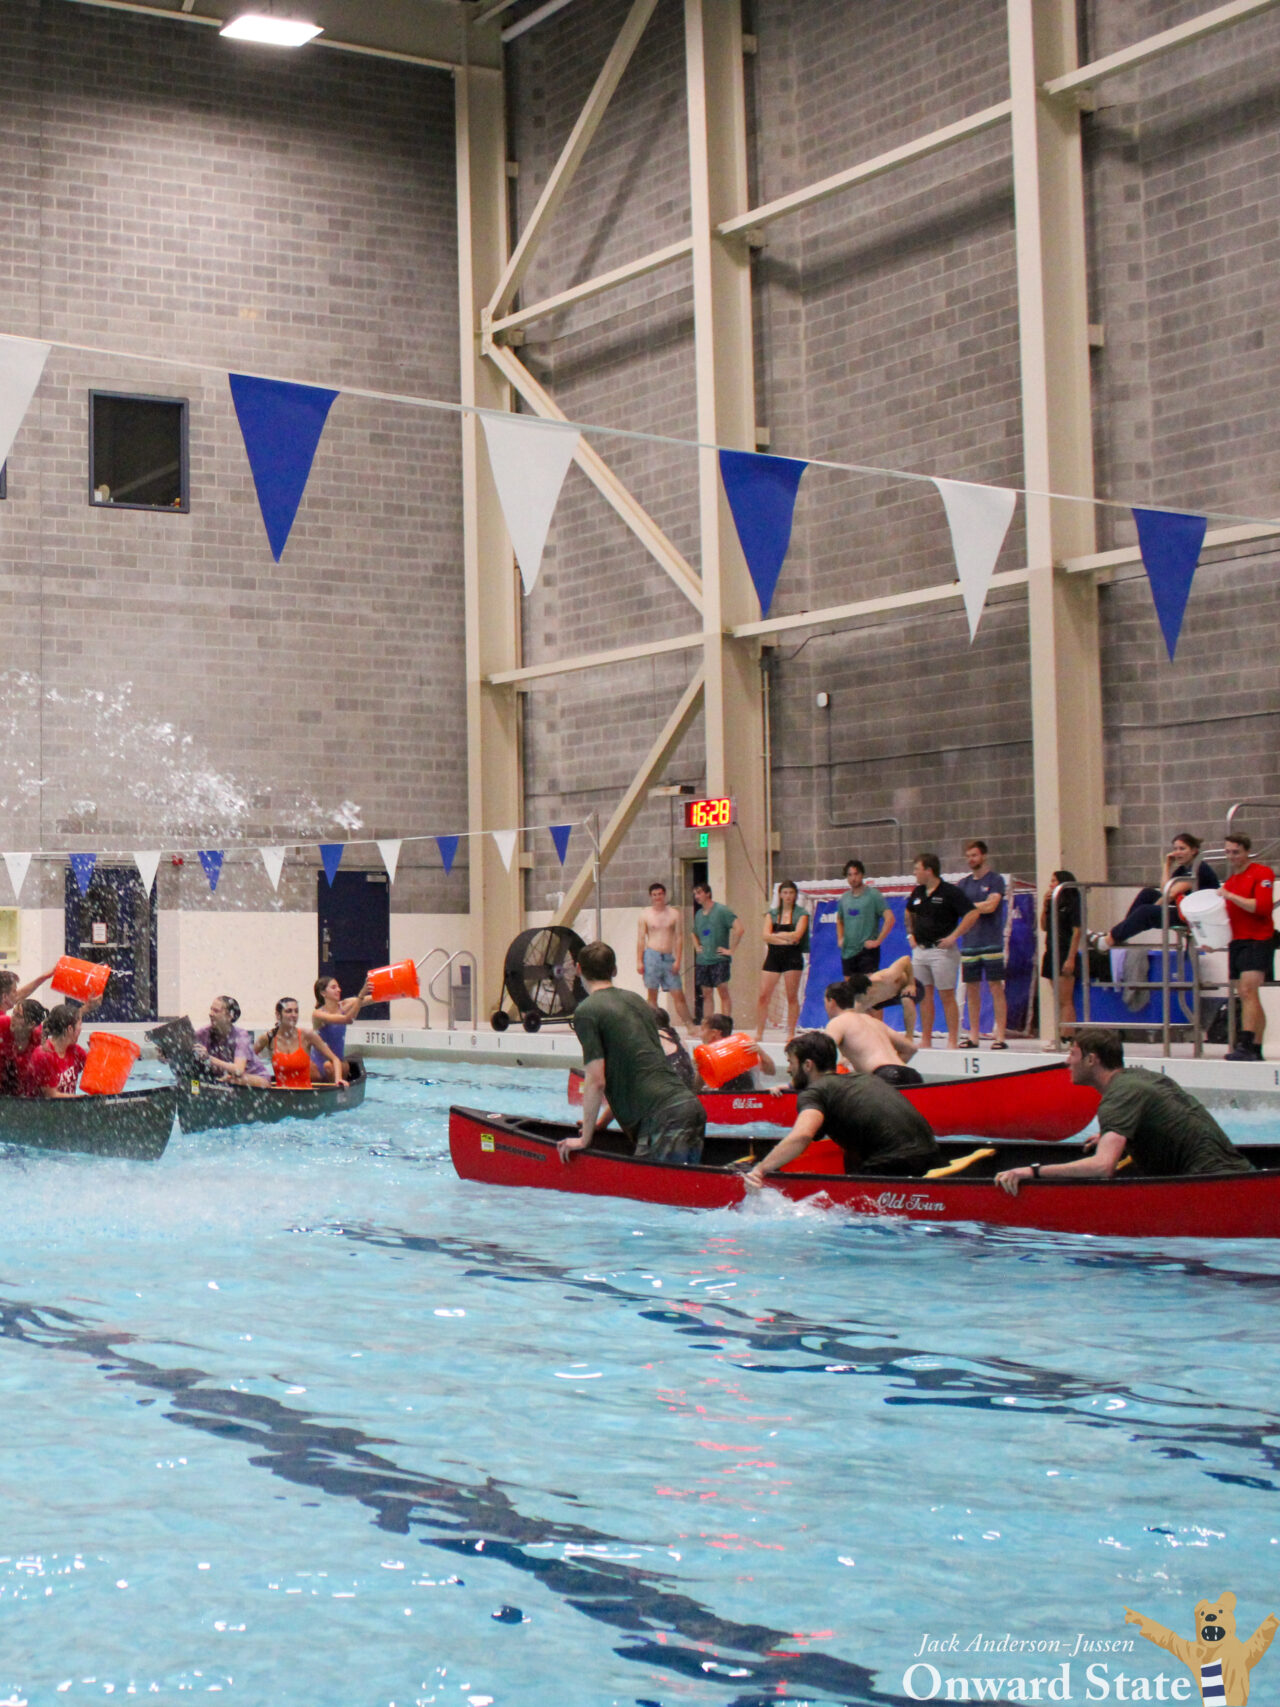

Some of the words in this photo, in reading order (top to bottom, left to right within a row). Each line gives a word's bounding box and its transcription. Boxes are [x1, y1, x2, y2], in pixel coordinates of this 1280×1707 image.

[692, 799, 730, 827] 16:28
[963, 1057, 980, 1073] 15
[878, 1191, 907, 1209] Old
[906, 1194, 946, 1211] Town
